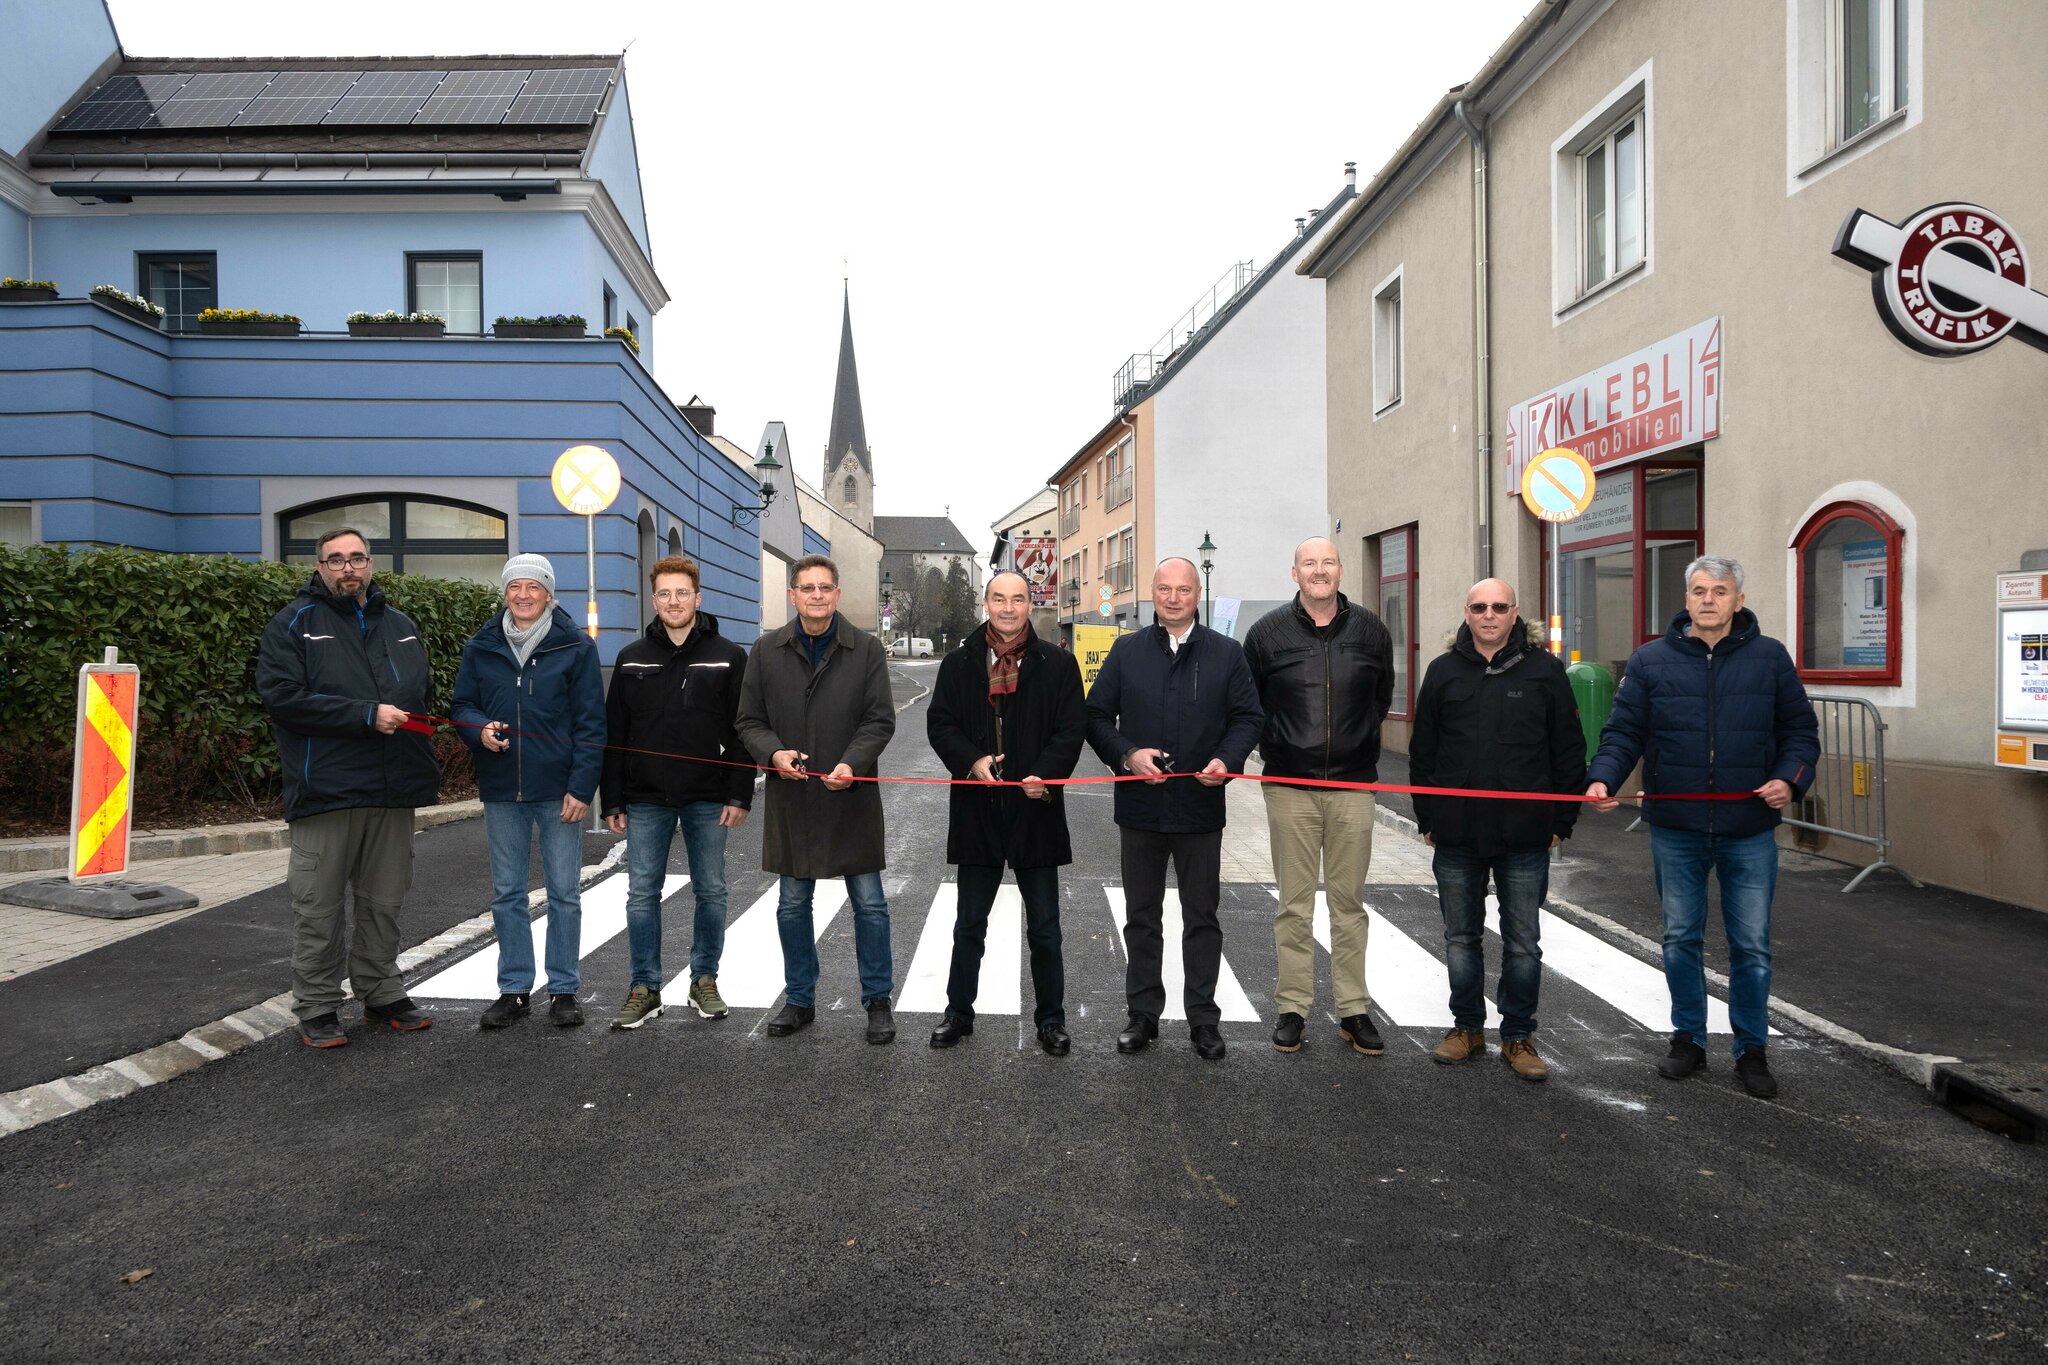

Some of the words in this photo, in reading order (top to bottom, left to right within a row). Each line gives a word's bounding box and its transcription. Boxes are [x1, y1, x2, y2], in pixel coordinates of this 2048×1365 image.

[1919, 215, 2021, 270] TABAK
[1901, 265, 1995, 339] TRAFIK
[1560, 353, 1680, 440] KLEBL
[1561, 411, 1680, 461] mobilien
[1538, 507, 1581, 521] ANFANG
[1599, 507, 1620, 518] KOSTBAR
[2005, 581, 2034, 589] Zigaretten
